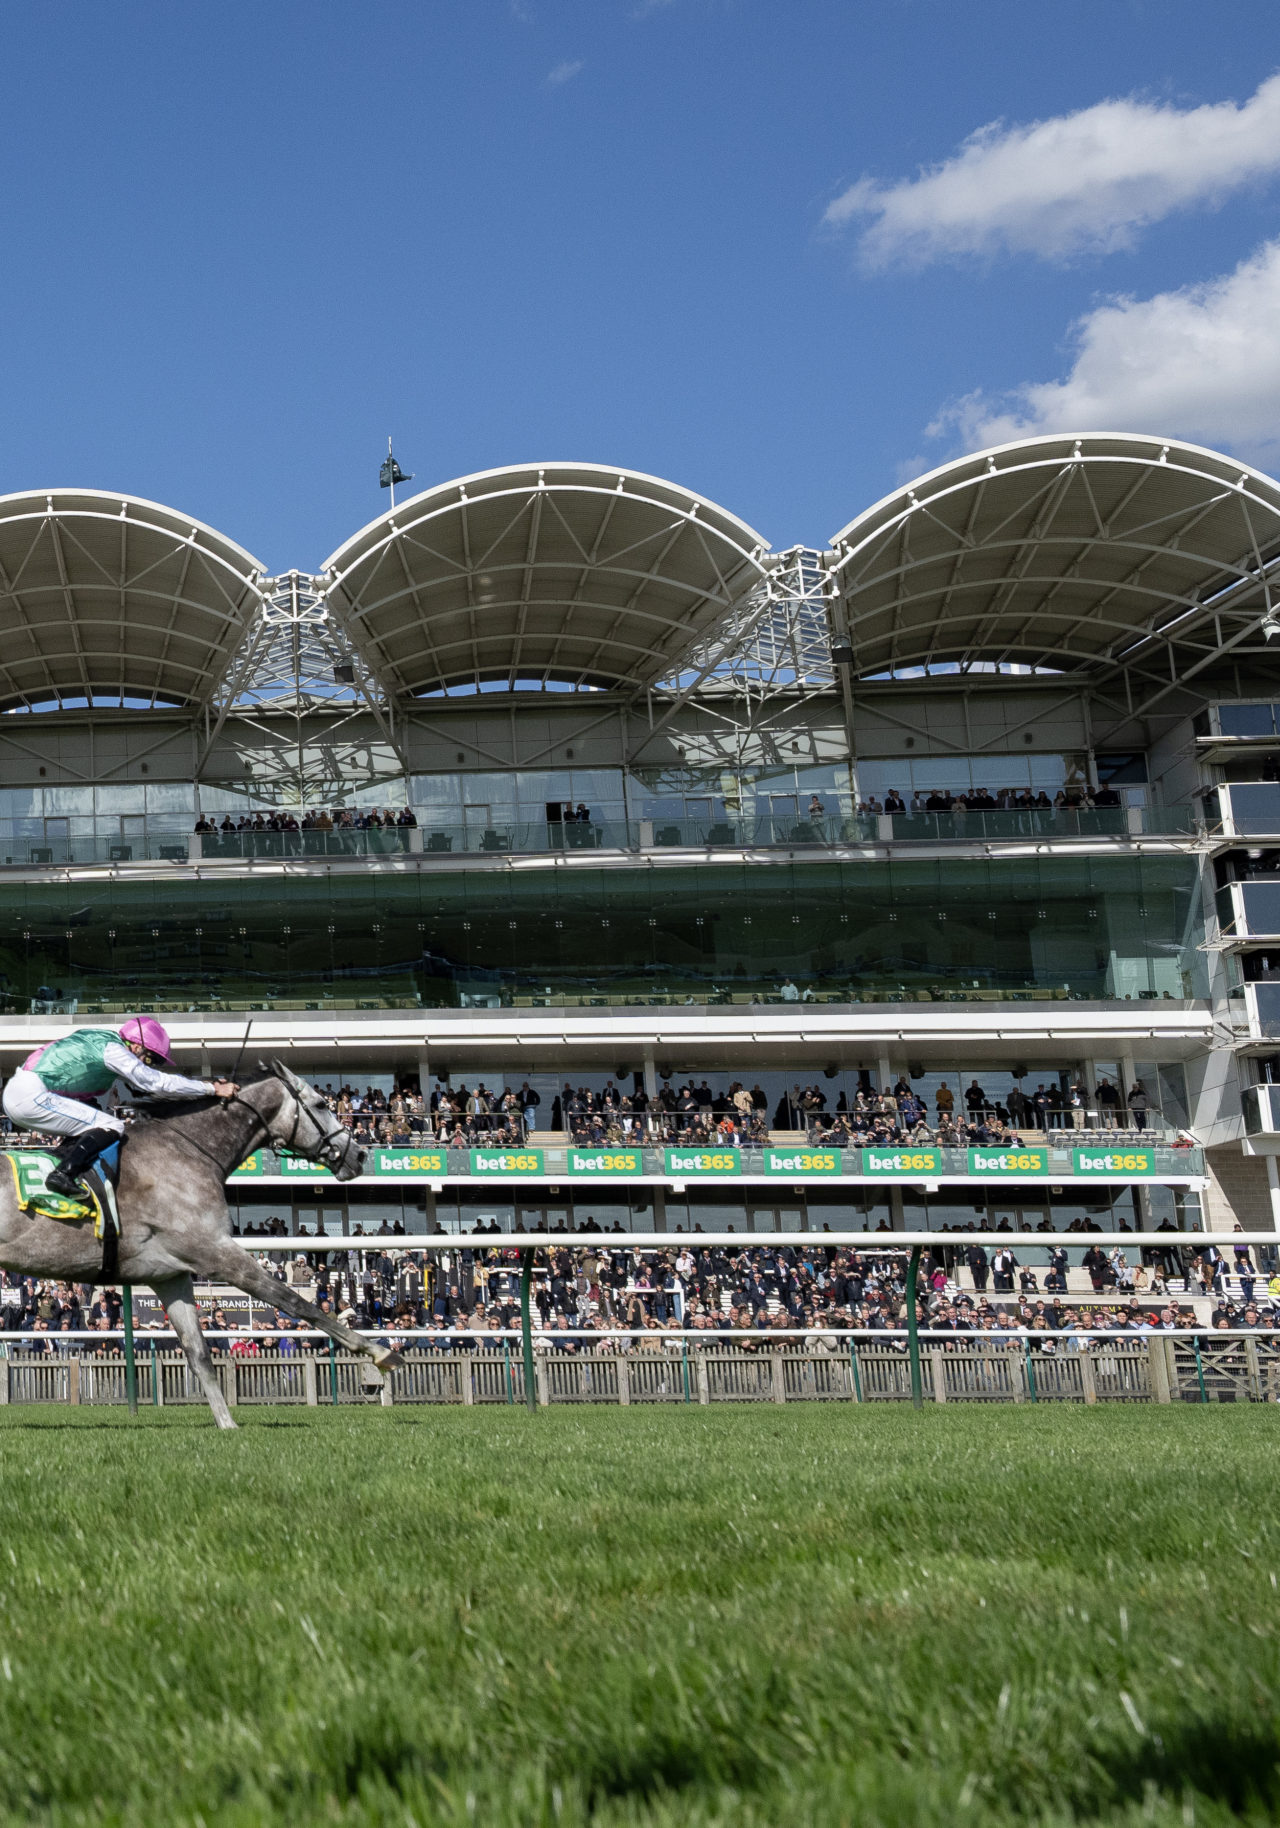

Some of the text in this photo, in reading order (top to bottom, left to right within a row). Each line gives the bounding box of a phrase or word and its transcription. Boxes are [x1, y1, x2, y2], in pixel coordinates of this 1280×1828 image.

[380, 1155, 441, 1170] bet365
[476, 1155, 538, 1170] bet365
[573, 1155, 636, 1170] bet365
[670, 1154, 735, 1169] bet365
[770, 1154, 835, 1169] bet365
[869, 1154, 935, 1169] bet365
[974, 1154, 1041, 1169] bet365
[1079, 1154, 1148, 1169] bet365
[19, 1156, 56, 1196] 3
[138, 1300, 156, 1308] THE
[217, 1300, 274, 1309] GRANDSTAN
